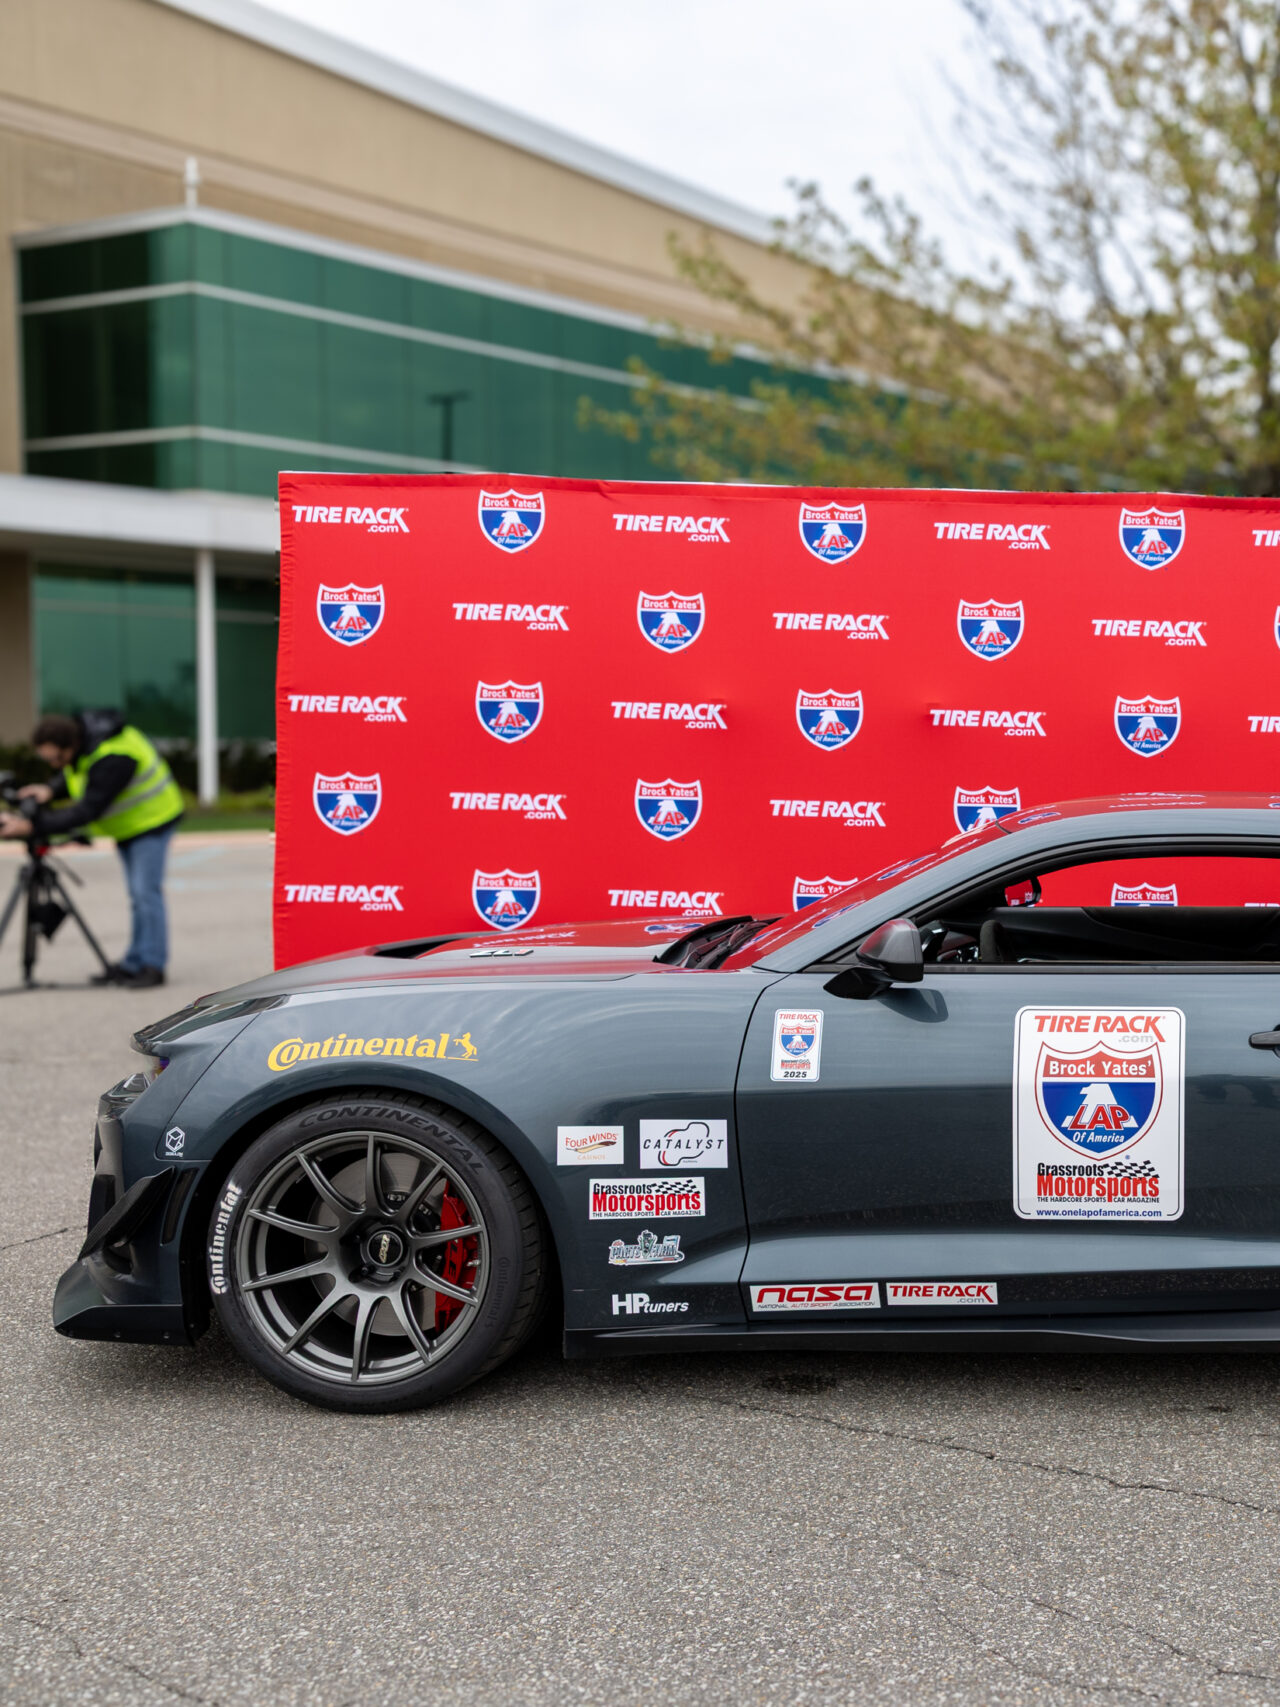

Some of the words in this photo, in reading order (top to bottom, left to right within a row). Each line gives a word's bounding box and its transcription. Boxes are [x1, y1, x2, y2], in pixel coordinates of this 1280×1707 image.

[292, 505, 343, 522] TIRE
[344, 506, 409, 532] RACK
[806, 511, 830, 520] Brock
[1126, 516, 1150, 524] Brock
[367, 524, 398, 532] .com
[496, 522, 527, 536] LAP
[613, 514, 664, 532] TIRE
[665, 516, 730, 541] RACK
[688, 532, 719, 541] .com
[816, 535, 848, 549] LAP
[934, 522, 985, 540] TIRE
[986, 524, 1051, 550] RACK
[1009, 541, 1040, 550] .com
[1136, 540, 1168, 554] LAP
[644, 600, 668, 608] Brock
[453, 603, 504, 620] TIRE
[505, 604, 570, 630] RACK
[964, 608, 988, 616] Brock
[334, 616, 366, 630] LAP
[528, 622, 559, 630] .com
[773, 613, 824, 630] TIRE
[825, 614, 890, 640] RACK
[654, 624, 686, 638] LAP
[848, 632, 879, 640] .com
[1092, 619, 1143, 636] TIRE
[1144, 620, 1209, 646] RACK
[974, 632, 1006, 646] LAP
[1167, 638, 1198, 646] .com
[288, 695, 339, 712] TIRE
[340, 696, 405, 722] RACK
[803, 698, 828, 706] Brock
[1121, 704, 1146, 712] Brock
[492, 713, 524, 727] LAP
[612, 702, 662, 720] TIRE
[664, 704, 728, 729] RACK
[686, 720, 718, 729] .com
[814, 722, 845, 736] LAP
[930, 710, 981, 727] TIRE
[982, 711, 1047, 736] RACK
[1005, 728, 1036, 736] .com
[1132, 728, 1163, 742] LAP
[642, 788, 666, 796] Brock
[450, 792, 501, 810] TIRE
[502, 794, 567, 819] RACK
[961, 795, 986, 804] Brock
[330, 805, 362, 819] LAP
[525, 810, 556, 819] .com
[652, 812, 684, 826] LAP
[770, 800, 821, 818] TIRE
[822, 802, 887, 827] RACK
[845, 818, 876, 827] .com
[284, 884, 336, 902] TIRE
[336, 886, 402, 912] RACK
[608, 890, 659, 907] TIRE
[660, 891, 725, 916] RACK
[1118, 892, 1142, 900] Brock
[1034, 1016, 1091, 1032] TIRE
[1093, 1016, 1166, 1042] RACK
[1118, 1035, 1154, 1043] .com
[268, 1033, 450, 1071] Continental
[1049, 1060, 1095, 1075] Brock
[1102, 1060, 1152, 1076] Yates'
[1068, 1104, 1131, 1130] LAP
[300, 1106, 487, 1176] CONTINENTAL
[565, 1136, 588, 1148] FOUR
[588, 1133, 617, 1142] WINDS
[643, 1139, 724, 1150] CATALYST
[1073, 1132, 1086, 1143] Of
[1087, 1132, 1125, 1143] America
[1037, 1163, 1104, 1176] Grassroots
[594, 1183, 652, 1195] Grassroots
[1037, 1173, 1160, 1202] Motorsports
[592, 1192, 701, 1216] Motorsports
[1036, 1209, 1162, 1218] www.onelapofamerica.com
[757, 1286, 874, 1303] nasa
[890, 1286, 934, 1297] TIRE
[937, 1286, 994, 1303] RACK
